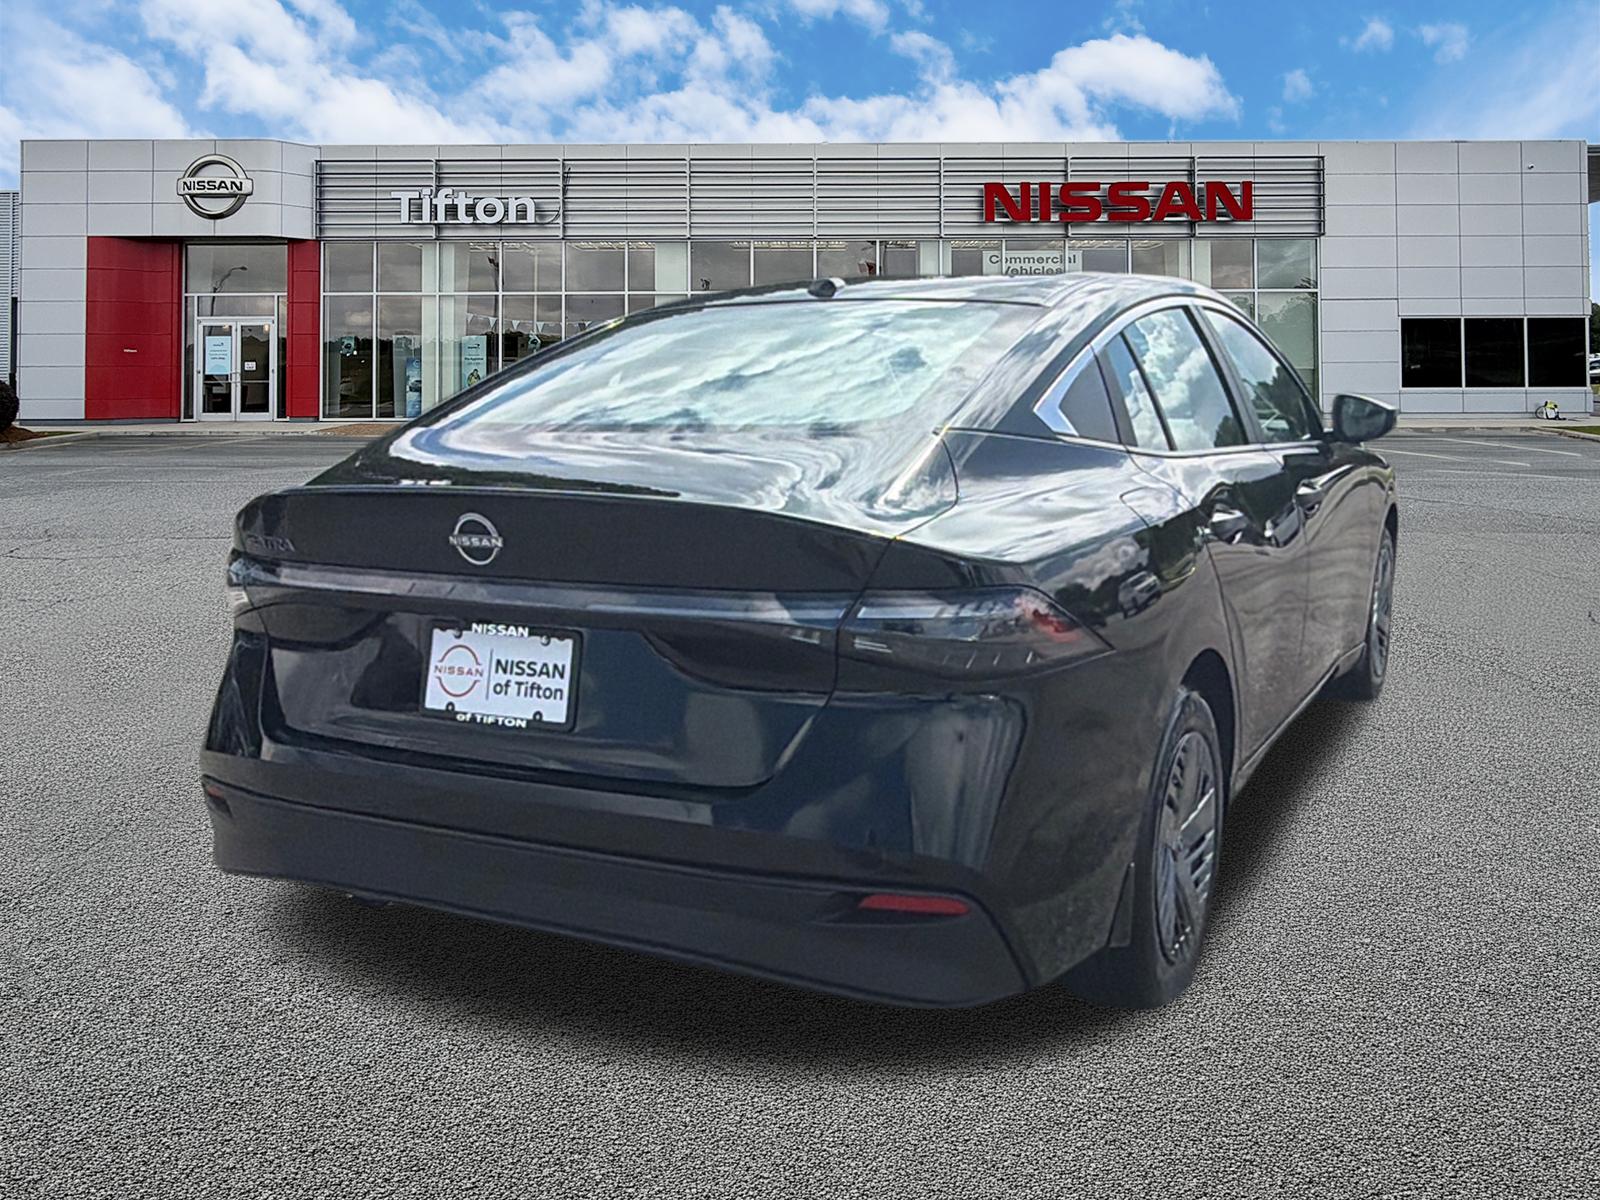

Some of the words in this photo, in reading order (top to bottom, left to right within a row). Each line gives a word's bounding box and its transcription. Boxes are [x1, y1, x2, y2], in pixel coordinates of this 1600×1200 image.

[183, 180, 243, 191] NISSAN
[391, 187, 536, 224] Tifton
[983, 181, 1254, 223] NISSAN
[448, 535, 504, 548] NISSAN
[471, 623, 529, 638] NISSAN
[433, 665, 484, 678] NISSAN
[494, 658, 566, 680] NISSAN
[493, 681, 511, 696] of
[515, 681, 564, 701] Tifton
[455, 713, 472, 723] of
[475, 715, 527, 729] TIFTON
